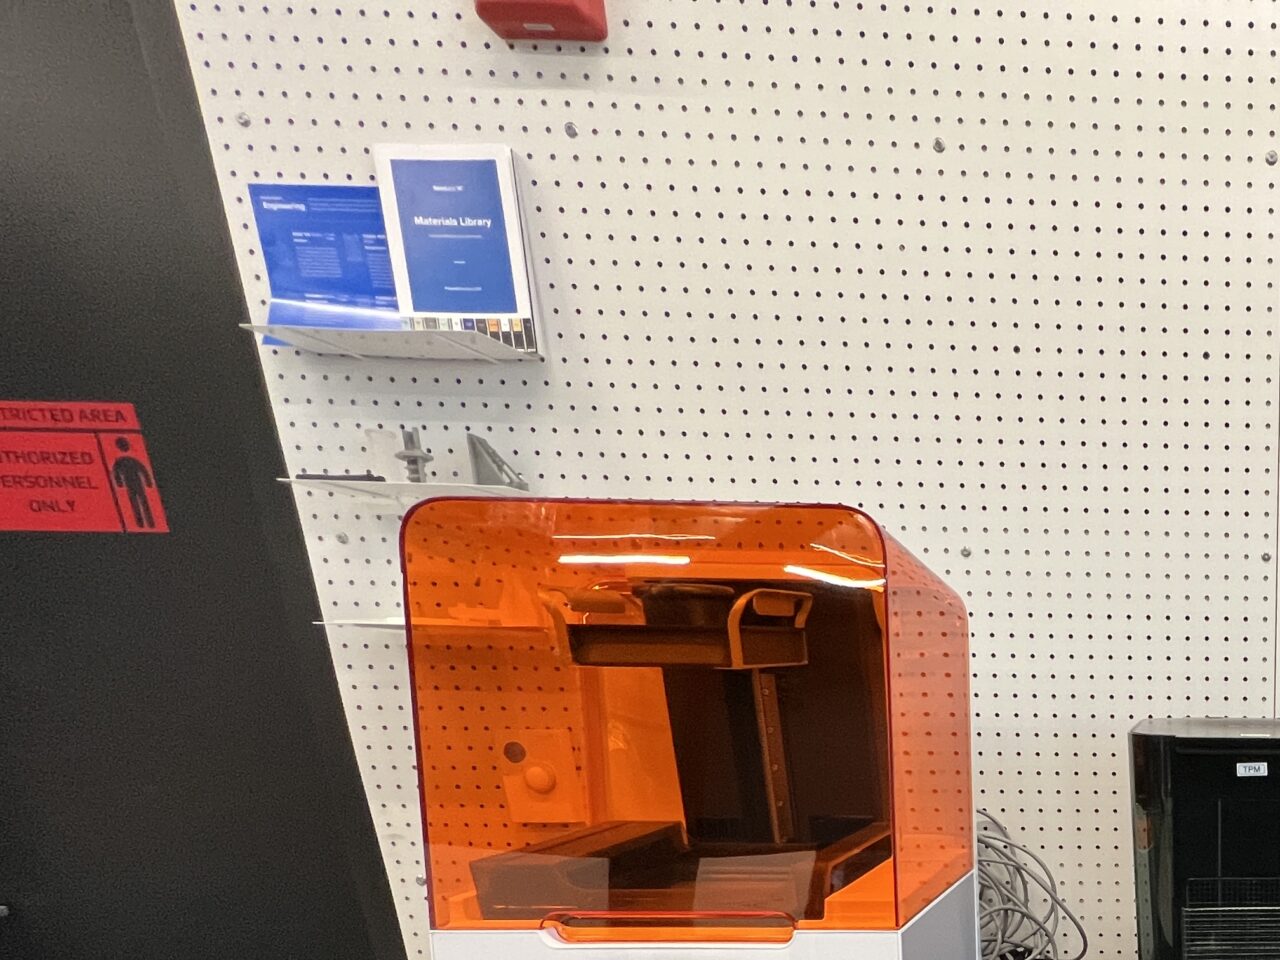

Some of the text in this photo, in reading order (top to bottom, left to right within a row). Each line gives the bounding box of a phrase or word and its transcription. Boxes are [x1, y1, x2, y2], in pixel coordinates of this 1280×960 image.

[414, 216, 492, 229] Materials Library
[79, 409, 127, 423] AREA
[0, 451, 94, 465] THORIZED
[0, 475, 99, 489] ERSONNEL
[29, 500, 76, 513] ONLY
[1243, 765, 1261, 774] TPM
